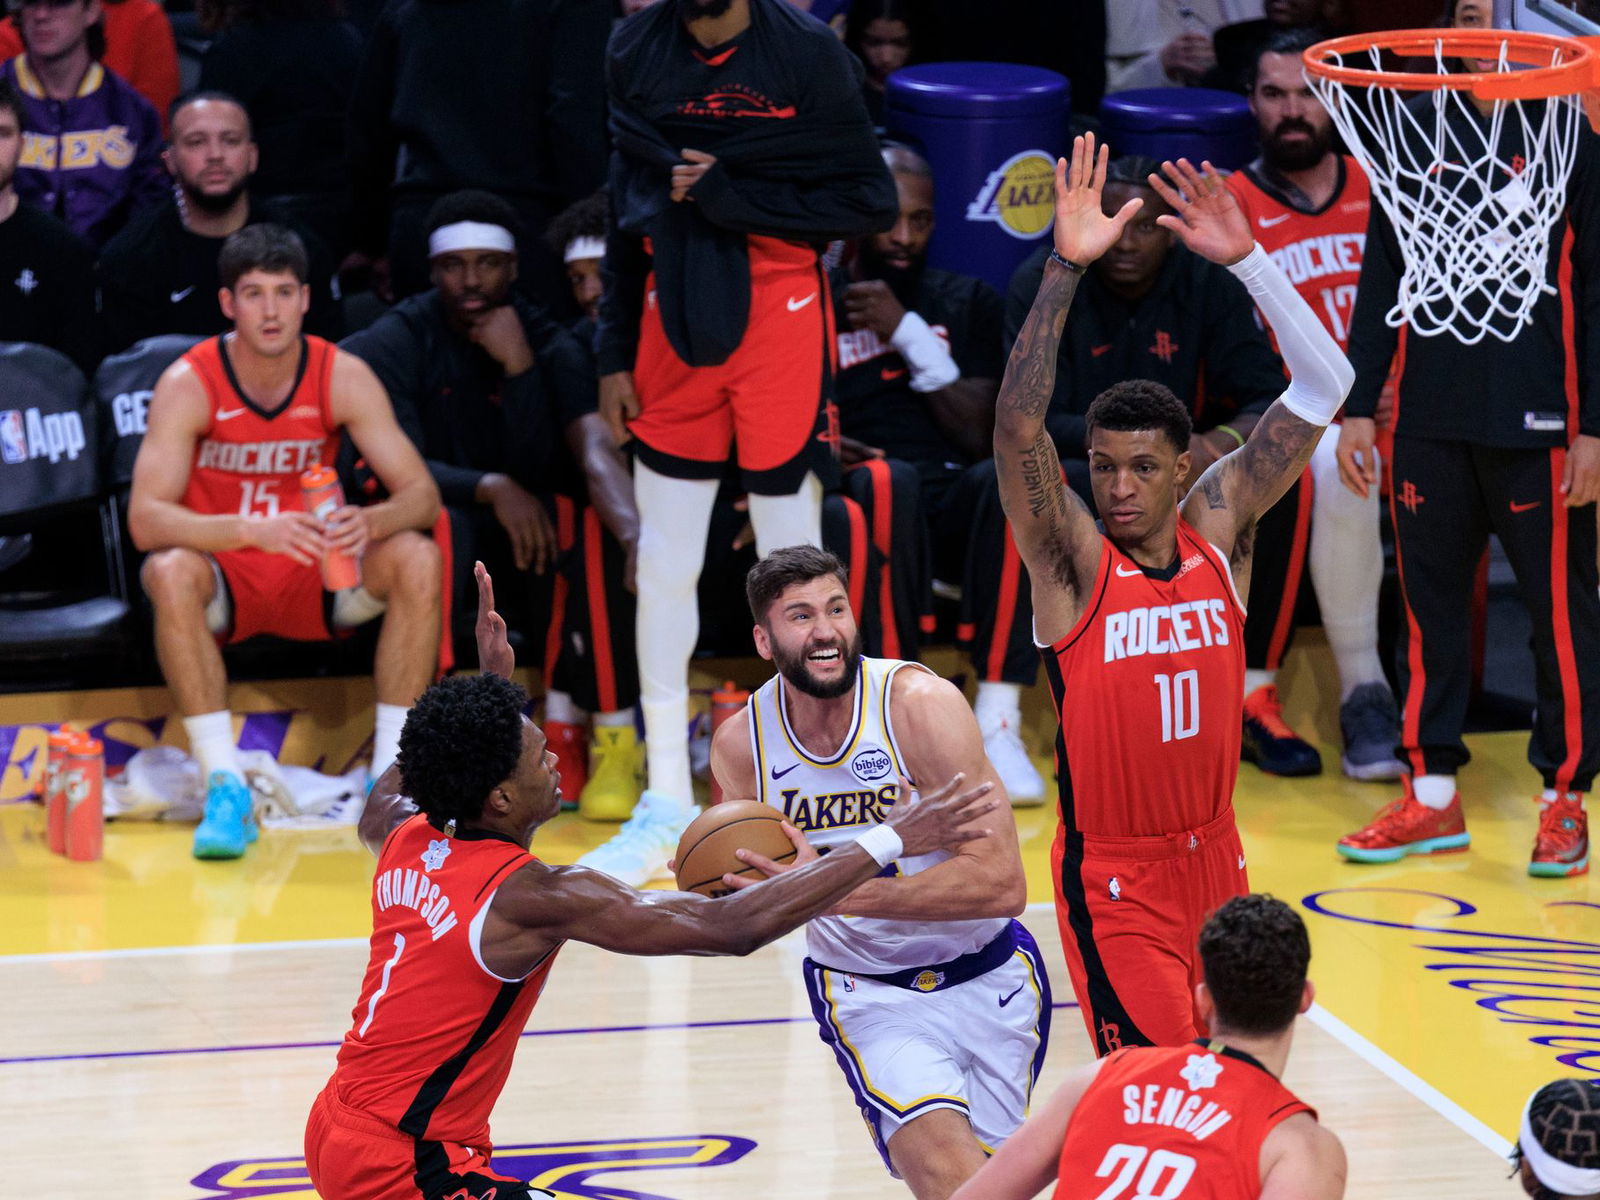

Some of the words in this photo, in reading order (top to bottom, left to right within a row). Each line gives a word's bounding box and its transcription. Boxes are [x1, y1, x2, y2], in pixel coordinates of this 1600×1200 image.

[25, 407, 86, 464] App
[112, 389, 155, 437] GE
[239, 479, 281, 519] 15
[1104, 598, 1230, 664] ROCETS
[1154, 669, 1200, 743] 10
[855, 757, 889, 771] bibigo
[781, 784, 897, 832] LAKERS
[376, 867, 459, 942] THOMPSON
[1094, 1143, 1197, 1200] 28
